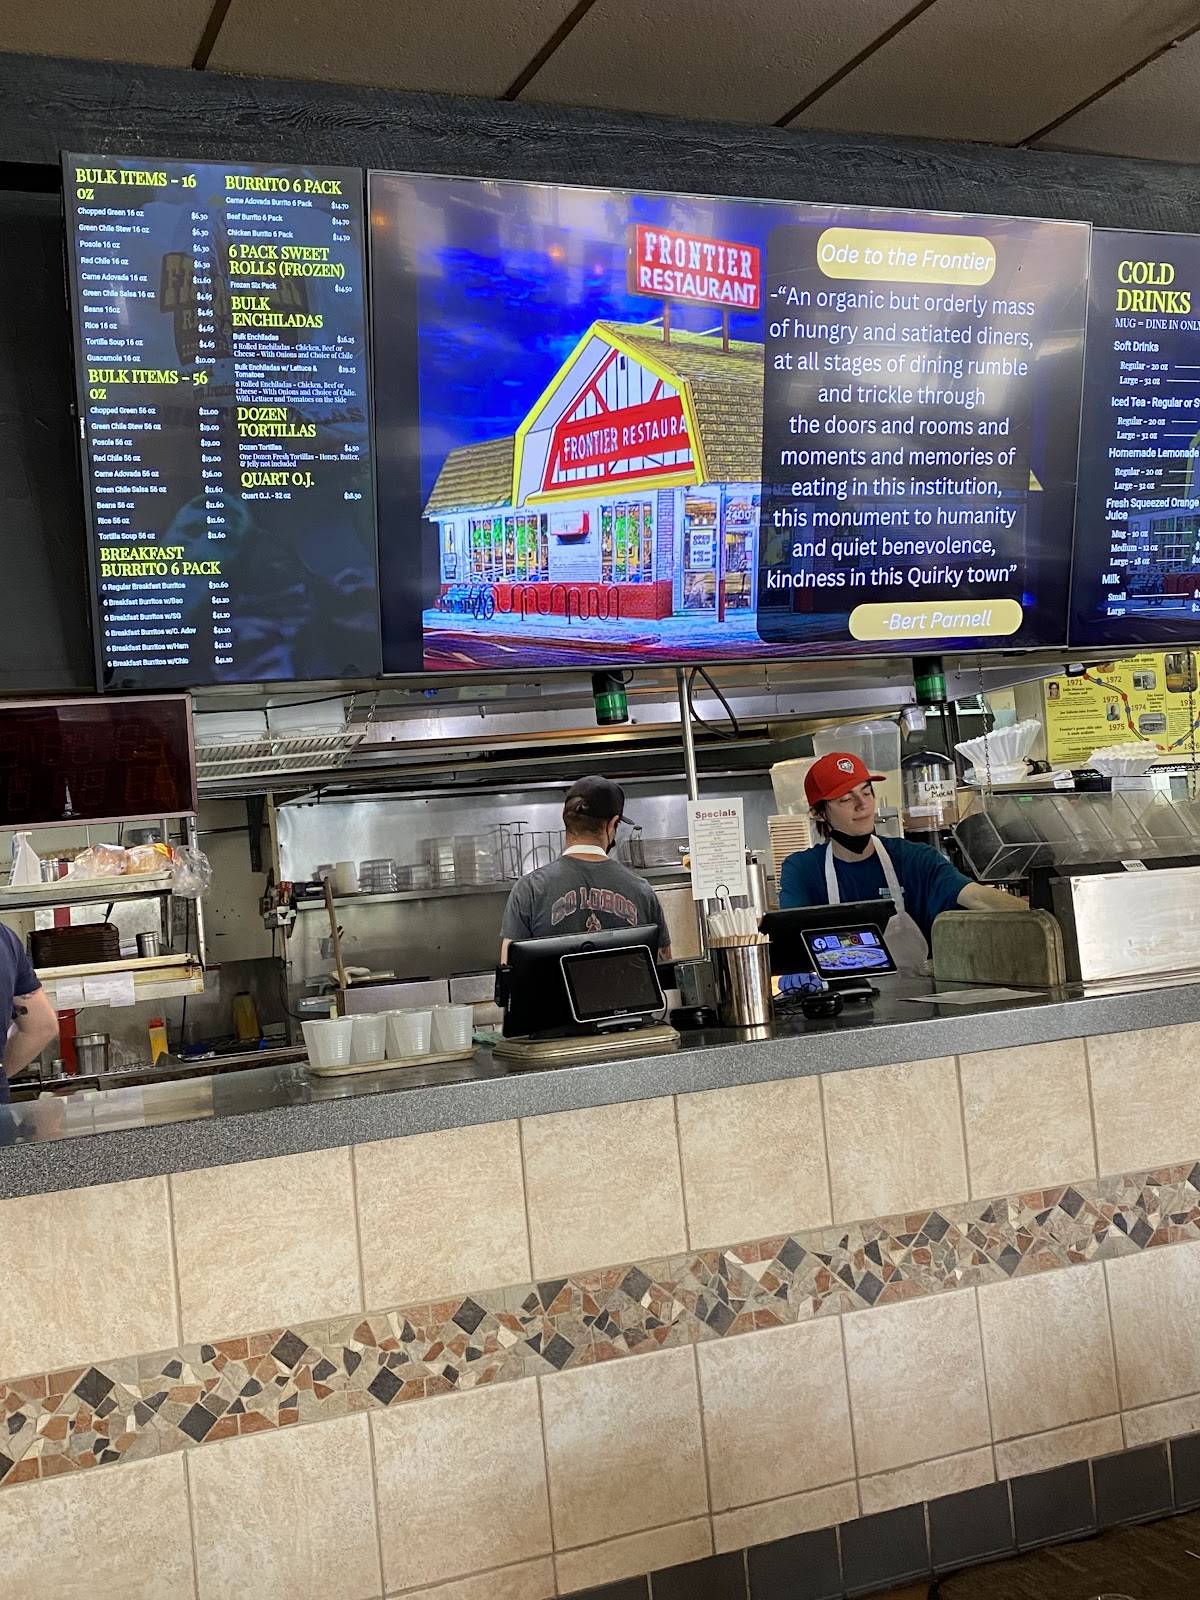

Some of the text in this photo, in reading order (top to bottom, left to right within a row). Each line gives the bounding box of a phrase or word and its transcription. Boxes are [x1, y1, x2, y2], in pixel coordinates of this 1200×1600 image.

[75, 168, 118, 184] BULK
[120, 170, 167, 187] ITEMS
[181, 173, 197, 188] 16
[225, 175, 342, 195] BURRITO 6 PACK
[76, 188, 94, 200] OZ
[78, 207, 107, 217] Chopped
[107, 208, 126, 217] Green
[127, 209, 135, 217] 16
[98, 224, 114, 232] Chile
[115, 225, 131, 233] Stew
[132, 225, 140, 233] 16
[79, 240, 102, 248] Posole
[102, 240, 111, 248] 16
[80, 256, 93, 264] Red
[94, 257, 110, 265] Chile
[111, 257, 119, 265] 16
[228, 244, 329, 261] 6 PACK SWEET
[644, 232, 753, 279] FRONTIER
[821, 243, 994, 271] Ode to the Frontier
[229, 260, 345, 280] ROLLS (FROZEN)
[1118, 260, 1175, 285] COLD
[640, 266, 757, 305] RESTAURANT
[231, 296, 271, 311] BULK
[816, 290, 885, 312] organic
[889, 291, 919, 311] but
[924, 294, 989, 319] orderly
[992, 299, 1035, 316] mass
[1116, 288, 1191, 314] DRINKS
[232, 312, 324, 329] ENCHILADAS
[1115, 317, 1136, 328] MUG
[1145, 318, 1168, 329] DINE
[1168, 319, 1178, 330] IN
[769, 318, 1034, 350] of hungry and satiated diners,
[1114, 340, 1159, 352] Soft Drinks
[773, 352, 1028, 379] at all stages of dining rumble
[1120, 361, 1146, 371] Regular
[88, 369, 130, 384] BULK
[132, 370, 178, 385] ITEMS
[193, 370, 208, 386] 56
[1120, 376, 1138, 386] Large
[90, 388, 106, 400] OZ
[818, 384, 985, 410] and trickle through
[1111, 396, 1129, 407] Iced
[1131, 396, 1146, 407] Tea
[1152, 397, 1182, 409] Regular
[1184, 399, 1193, 407] or
[237, 407, 288, 421] DOZEN
[237, 423, 317, 438] TORTILLAS
[789, 415, 1010, 436] the doors and rooms and
[239, 443, 283, 451] Dozen Tortillas
[563, 427, 618, 462] FRONTIER
[1108, 447, 1200, 458] Homemade Lemonade
[781, 447, 1016, 466] moments and memories of
[240, 472, 315, 488] QUART O.J.
[791, 477, 1003, 500] eating in this institution,
[1106, 497, 1200, 510] Fresh Squeezed Orange
[773, 506, 1016, 528] this monument to humanity
[1105, 510, 1128, 520] Juice
[100, 546, 184, 561] BREAKFAST
[792, 536, 996, 561] and quiet benevolence,
[101, 561, 221, 577] BURRITO 6 PACK
[766, 570, 846, 589] kindness
[850, 569, 866, 587] in
[870, 567, 903, 586] this
[907, 566, 963, 589] Quirky
[1102, 574, 1120, 584] Milk
[1107, 592, 1126, 601] Small
[1107, 607, 1126, 616] Large
[883, 609, 992, 631] -Bert Parnell
[695, 809, 737, 820] Specials
